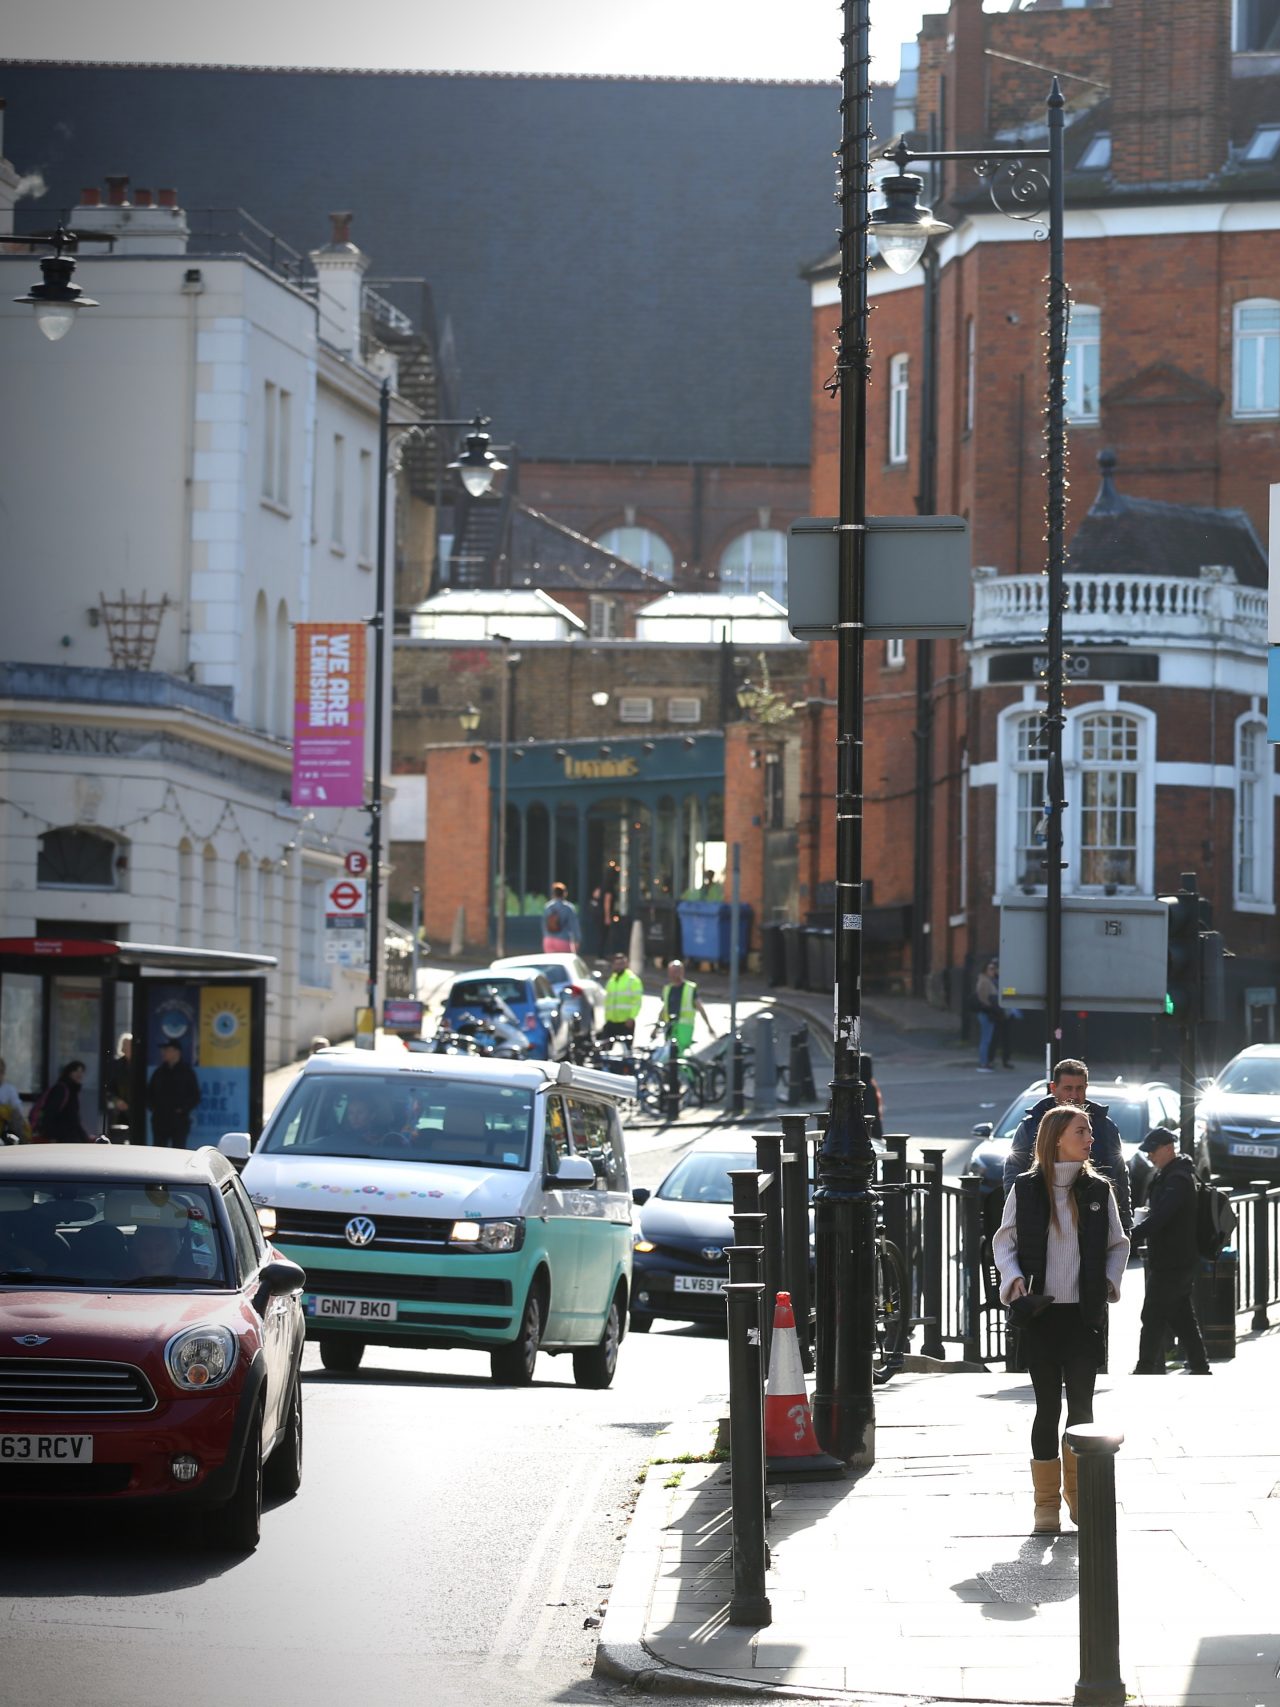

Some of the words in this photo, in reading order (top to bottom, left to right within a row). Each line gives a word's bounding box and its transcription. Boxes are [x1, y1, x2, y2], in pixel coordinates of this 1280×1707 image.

[329, 633, 351, 674] WE
[308, 633, 329, 728] LEWISHAM
[327, 677, 350, 728] ARE
[50, 726, 121, 754] BANK
[350, 855, 362, 872] E
[682, 1278, 715, 1291] LV69
[321, 1298, 355, 1315] GN17
[38, 1437, 84, 1458] RCV
